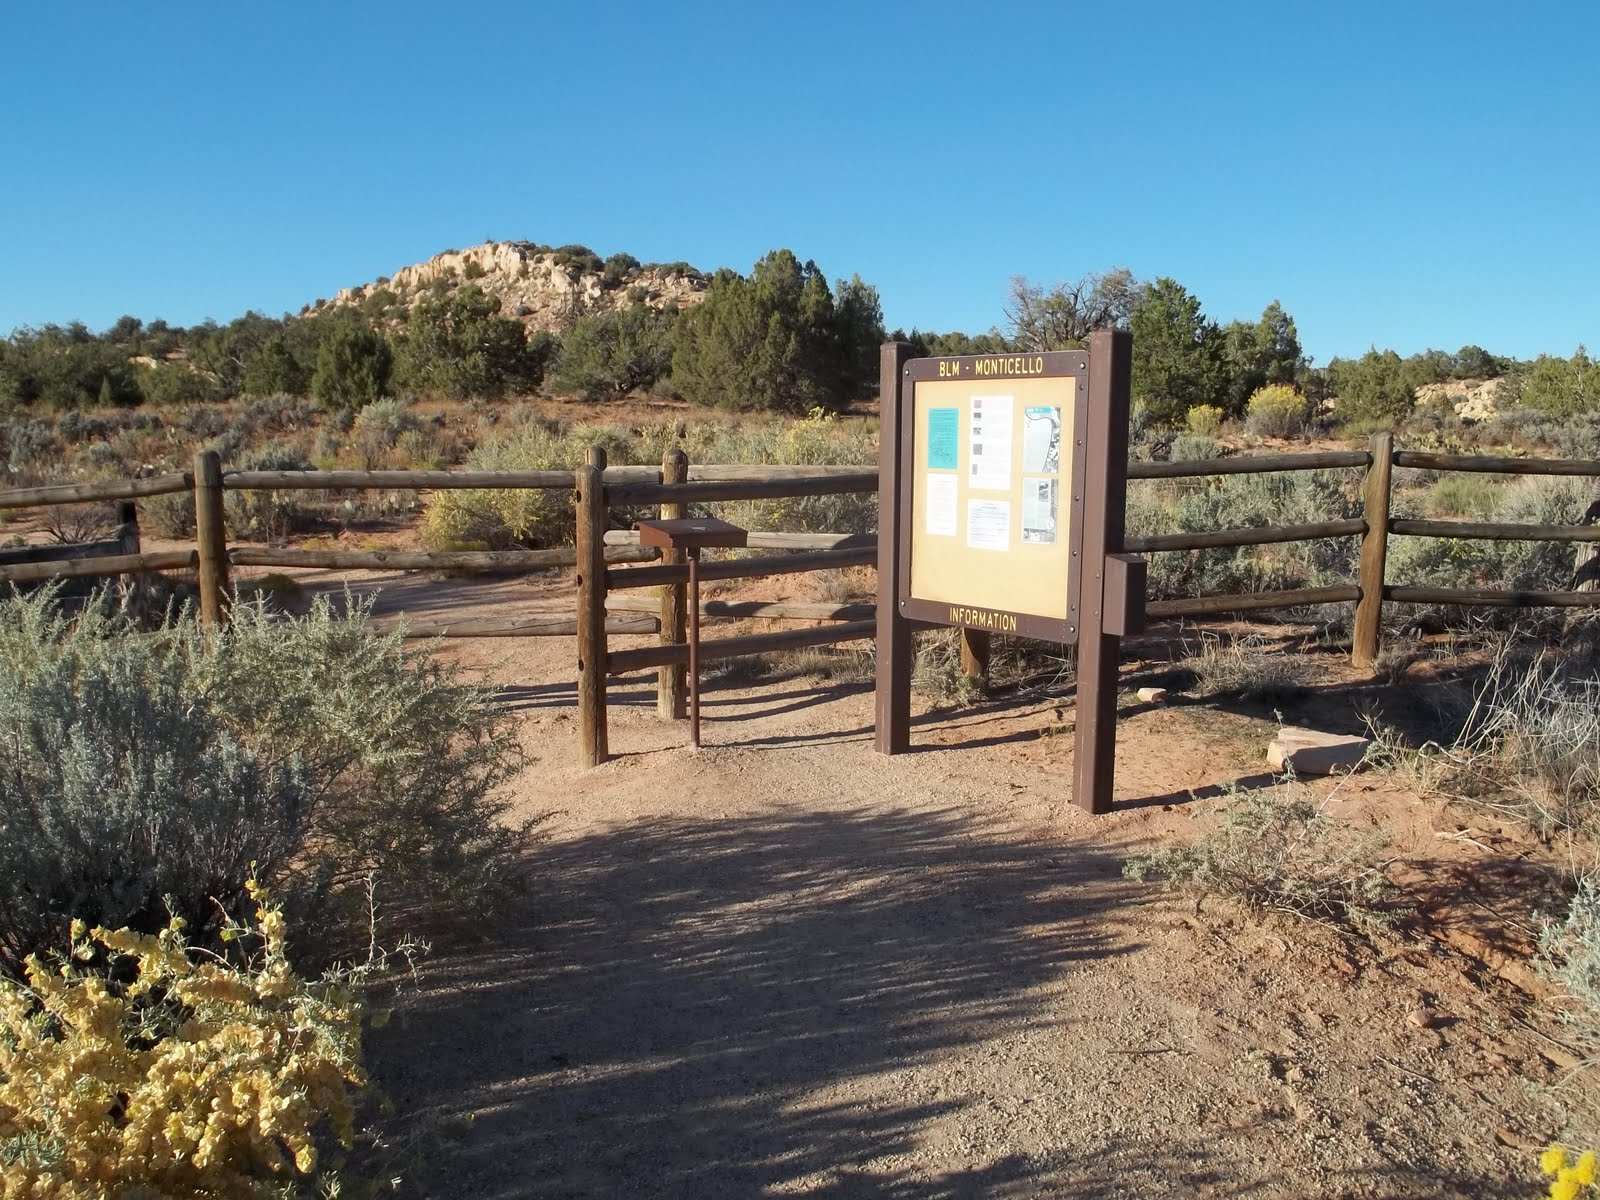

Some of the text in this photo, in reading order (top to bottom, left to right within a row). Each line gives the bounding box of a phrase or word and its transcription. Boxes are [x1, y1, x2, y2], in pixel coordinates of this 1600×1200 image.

[939, 356, 1043, 377] BLM MONTICELLO
[949, 607, 1017, 632] INFORMATION
